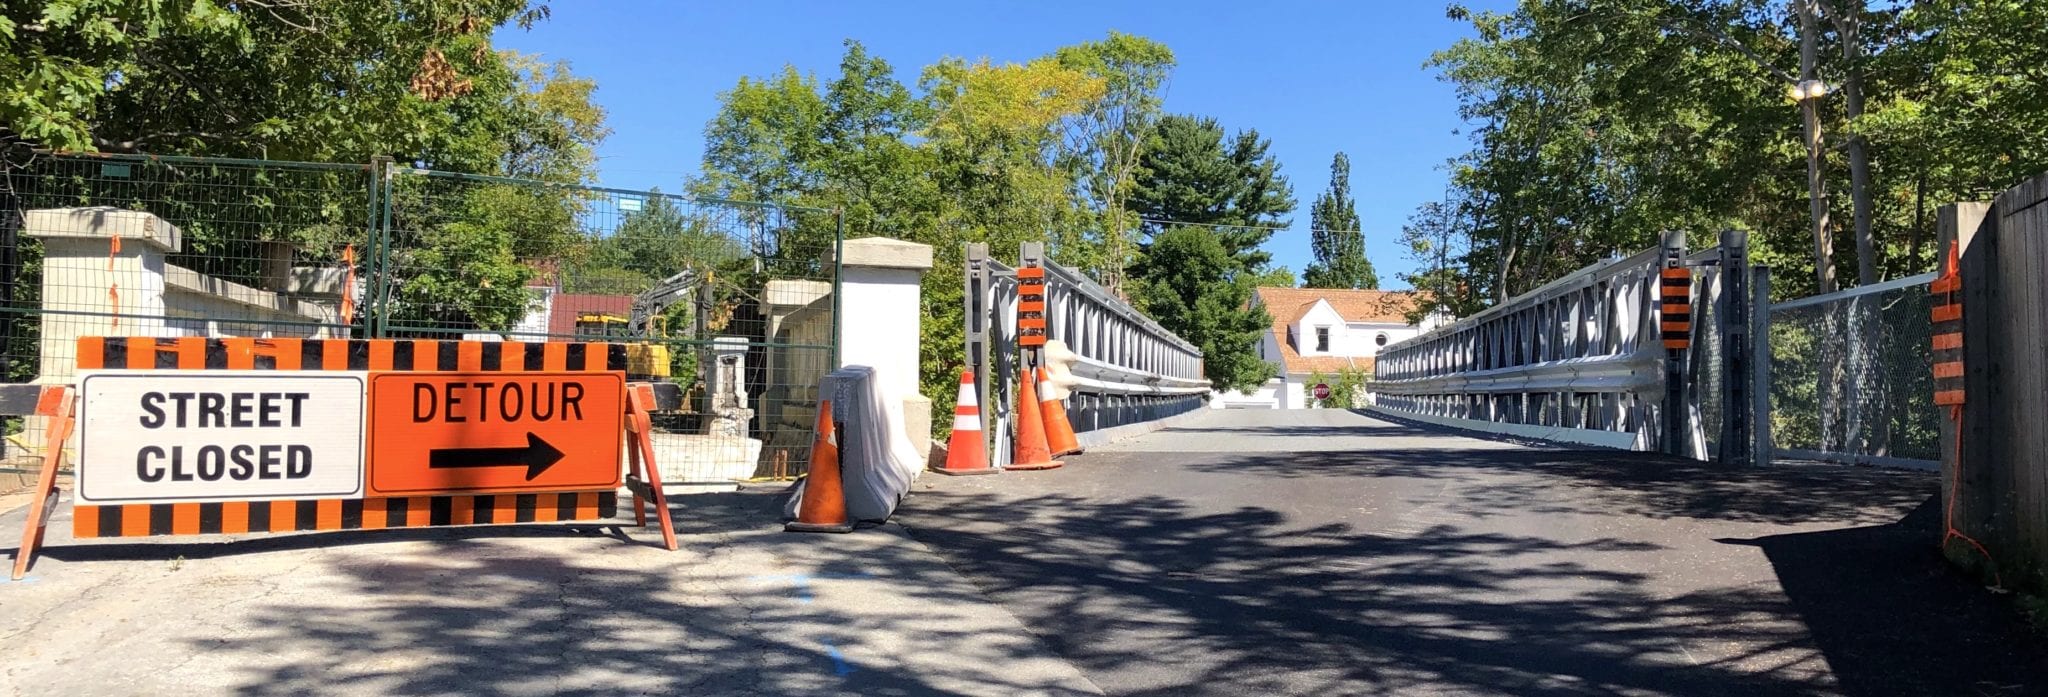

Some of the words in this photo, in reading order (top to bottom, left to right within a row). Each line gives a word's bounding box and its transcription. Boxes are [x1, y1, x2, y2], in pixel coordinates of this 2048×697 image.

[139, 391, 310, 429] STREET
[413, 382, 585, 423] DETOUR
[1314, 387, 1329, 395] STOP
[136, 444, 313, 482] CLOSED
